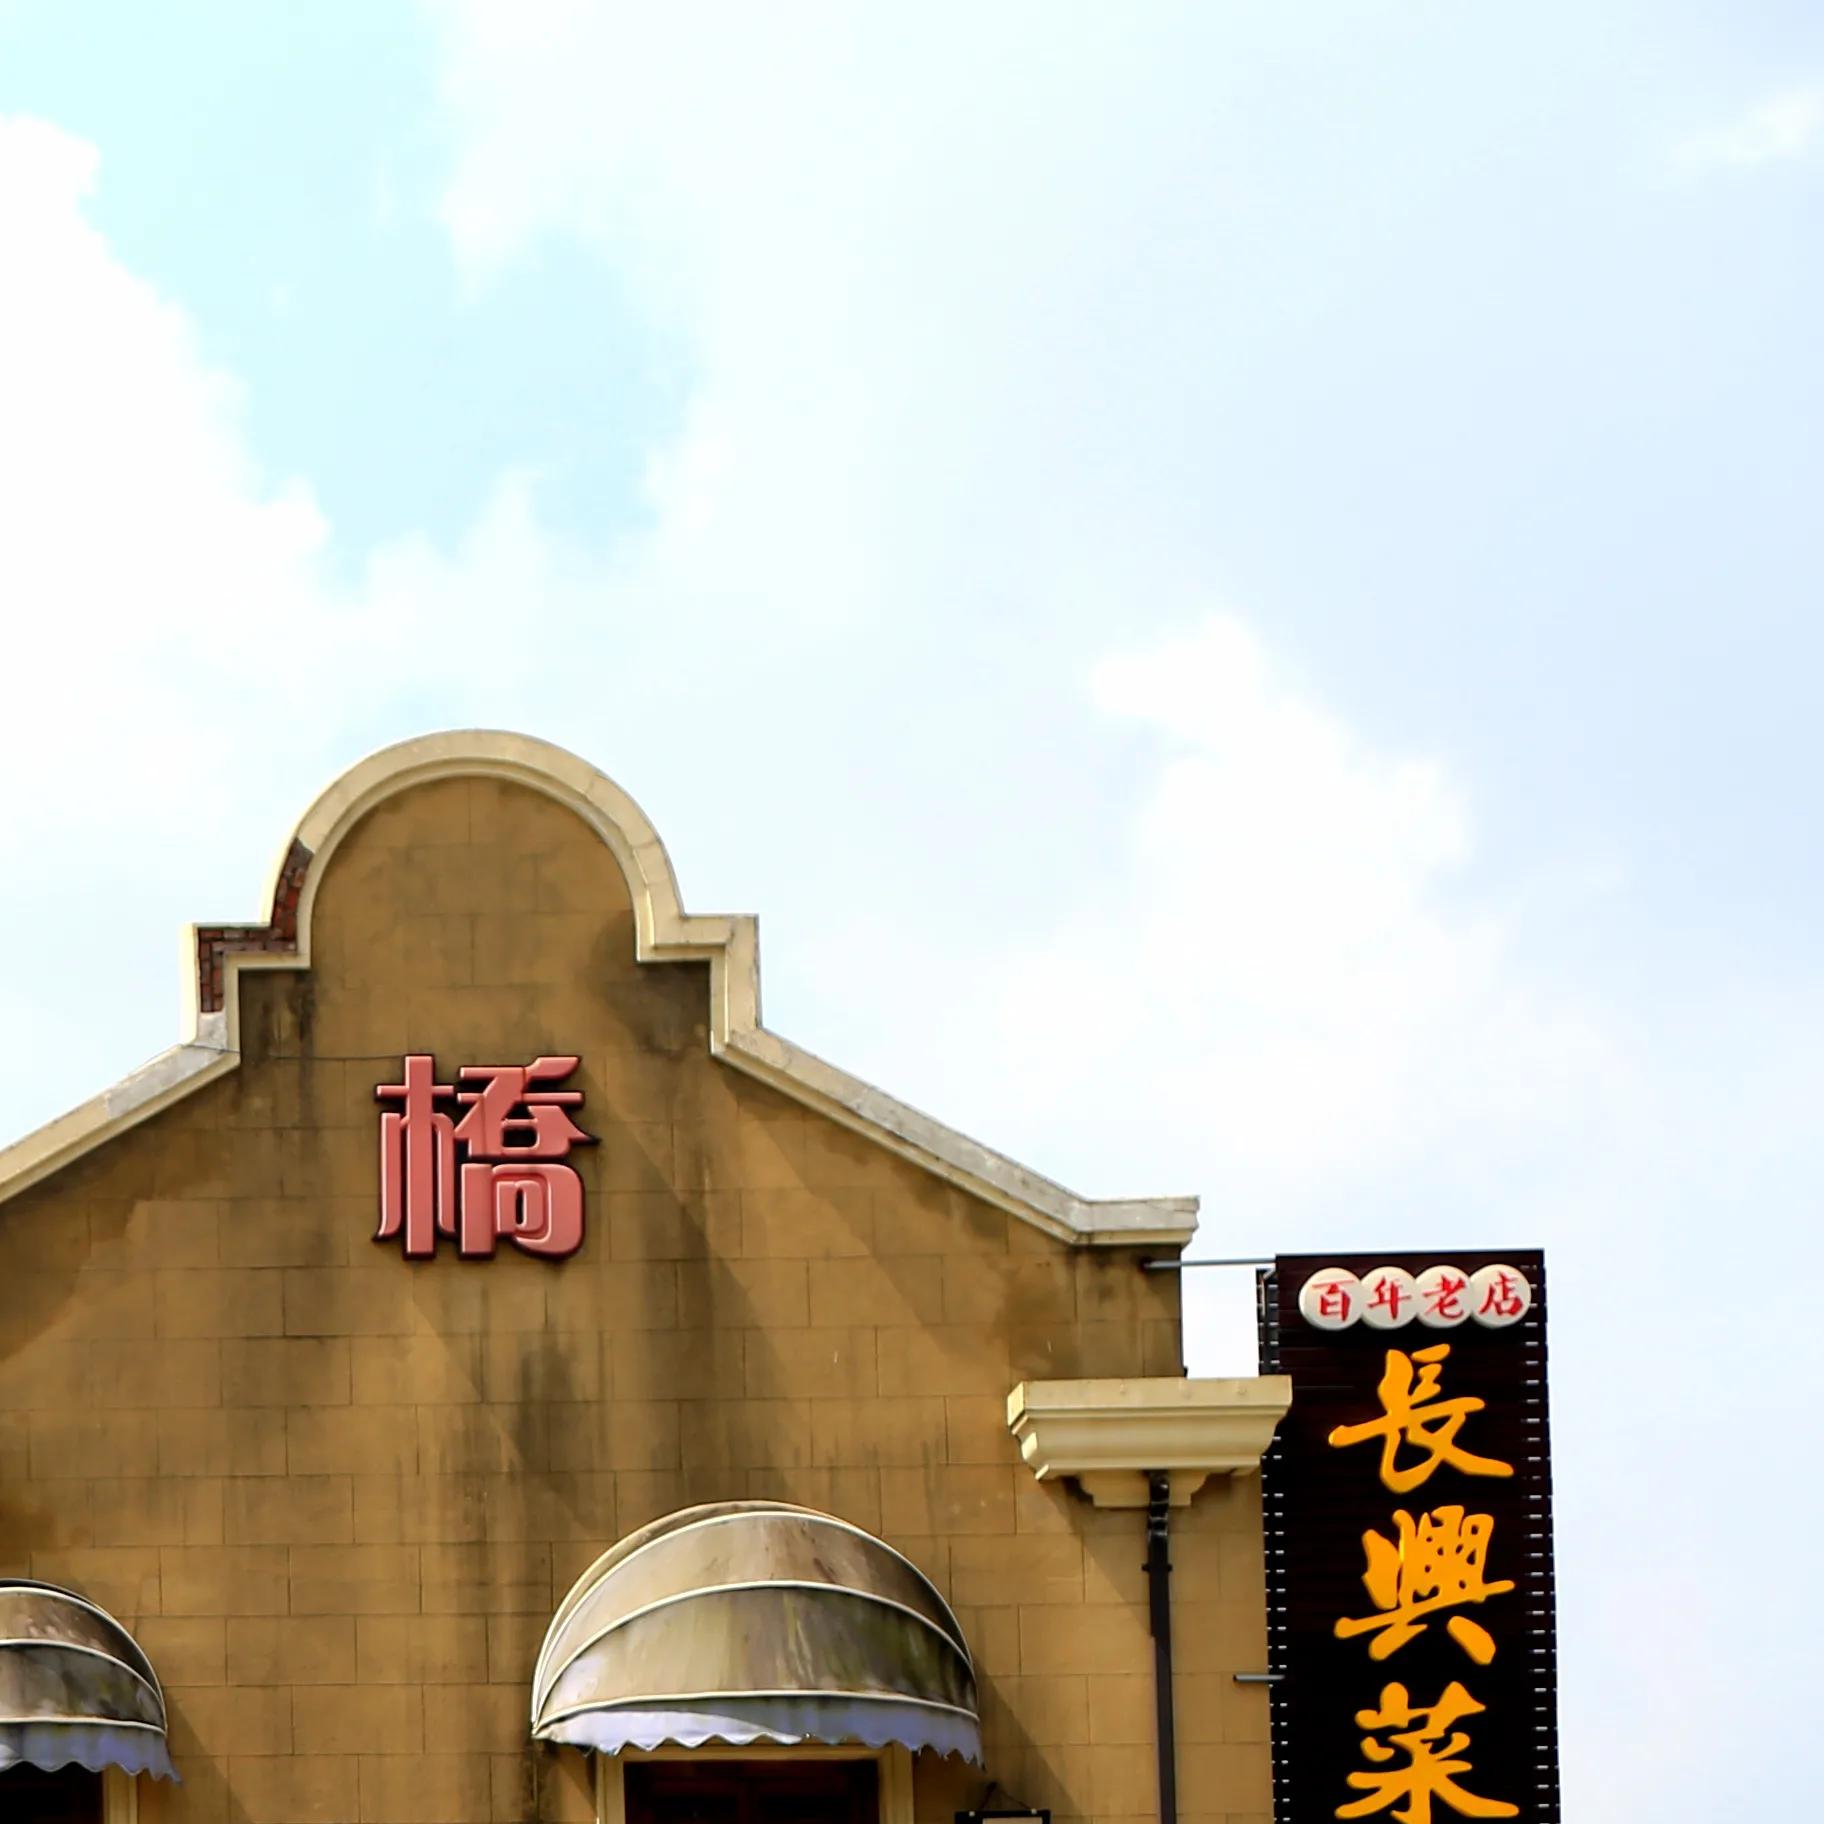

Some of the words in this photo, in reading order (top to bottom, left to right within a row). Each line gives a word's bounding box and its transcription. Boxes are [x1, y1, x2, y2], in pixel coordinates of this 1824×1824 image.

[373, 1054, 598, 1261] 橋
[1311, 1271, 1523, 1322] 百年老店
